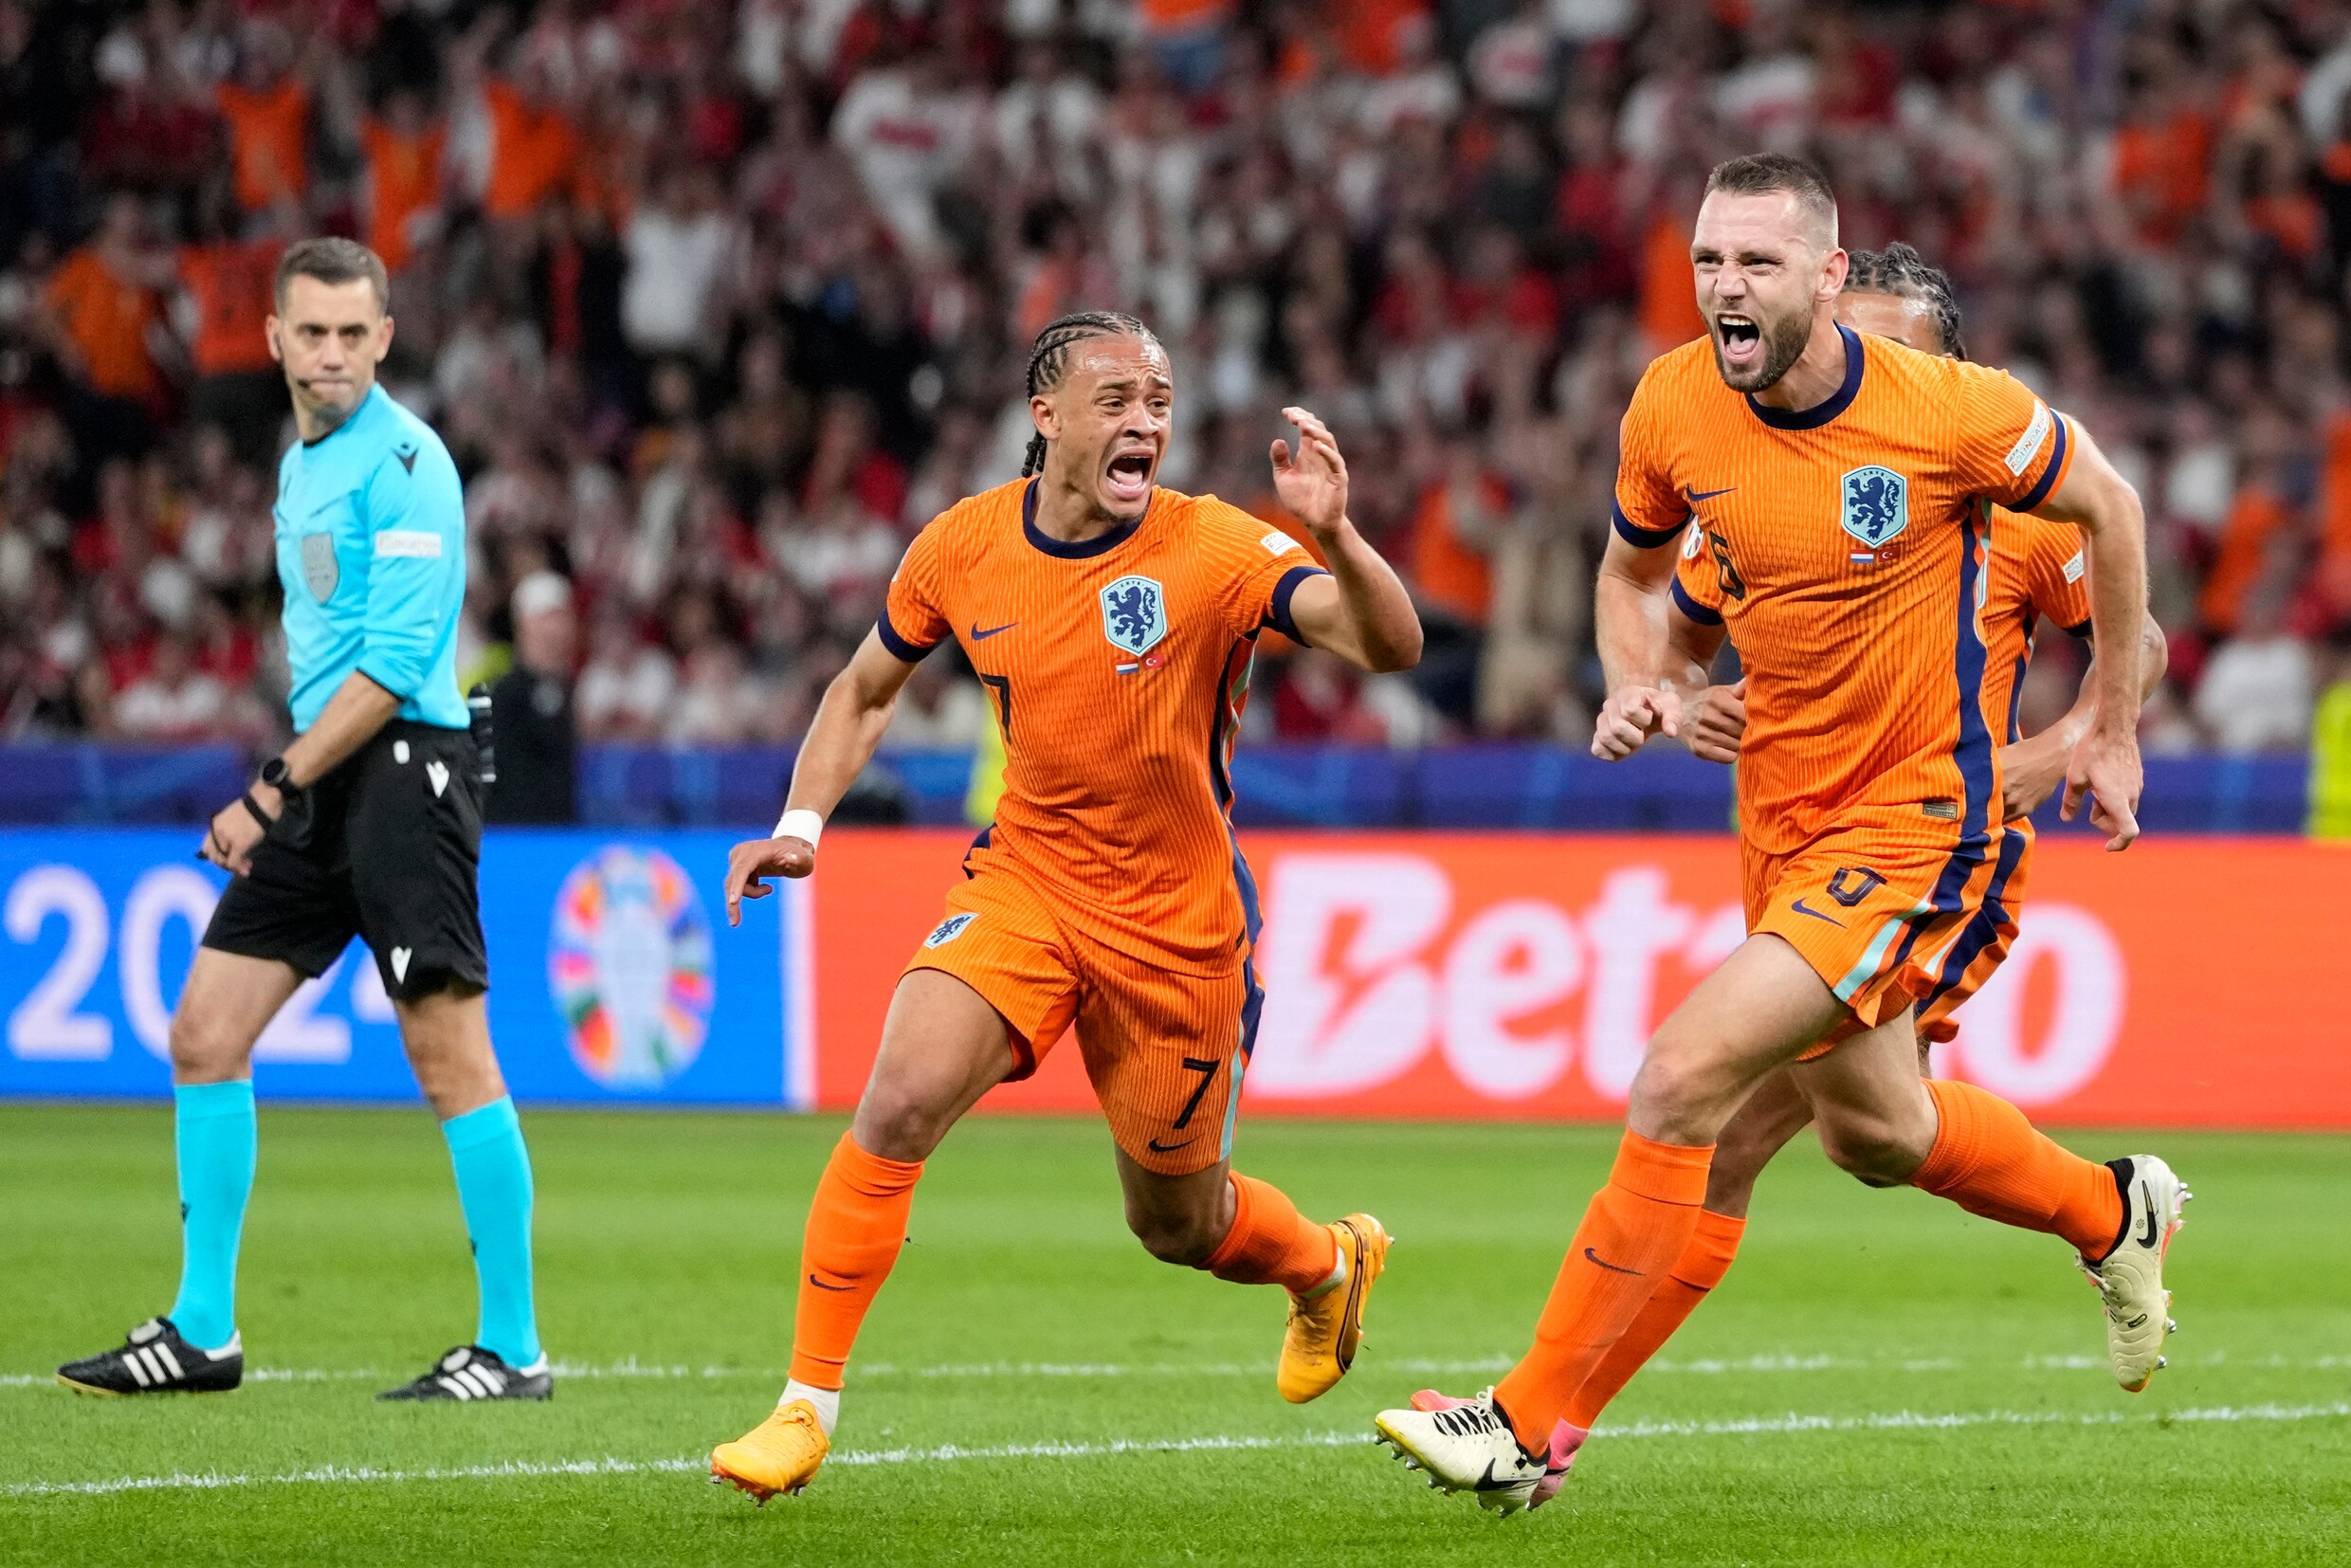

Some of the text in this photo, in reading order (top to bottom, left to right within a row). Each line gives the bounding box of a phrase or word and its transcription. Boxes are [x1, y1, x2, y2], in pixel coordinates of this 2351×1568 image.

[979, 672, 1011, 746] 7
[6, 864, 398, 1063] 20
[1249, 851, 2126, 1103] Beto
[1172, 1056, 1221, 1129] 7
